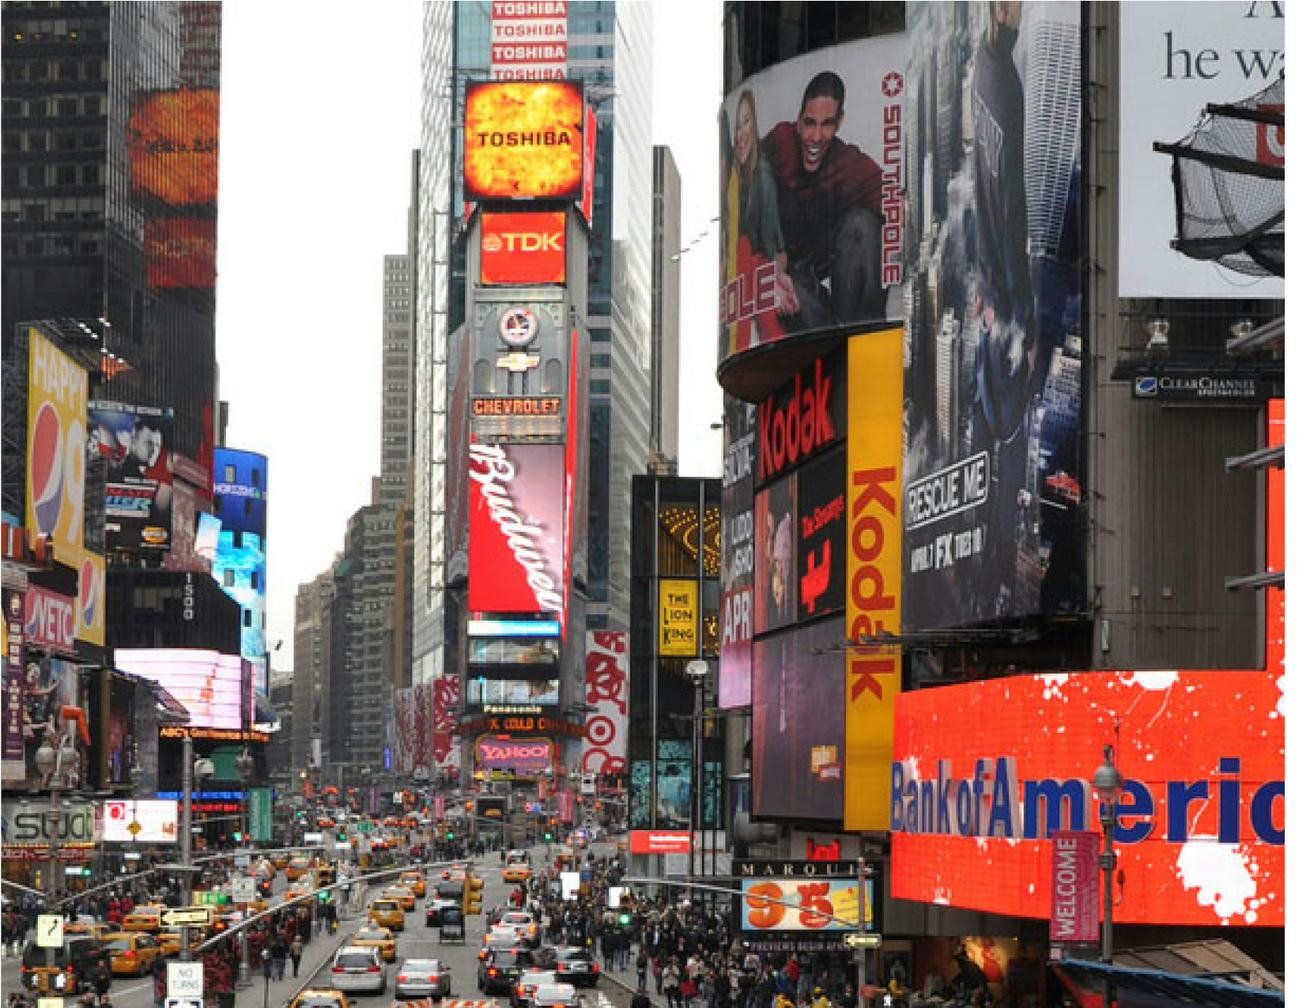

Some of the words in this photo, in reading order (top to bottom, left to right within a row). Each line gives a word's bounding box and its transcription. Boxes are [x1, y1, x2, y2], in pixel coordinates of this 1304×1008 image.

[494, 2, 566, 14] TOSHIBA
[494, 25, 566, 37] TOSHIBA
[494, 46, 567, 60] TOSHIBA
[1162, 31, 1221, 80] he
[494, 68, 566, 80] TOSHIBA
[477, 131, 571, 147] TOSHIBA
[882, 103, 904, 288] SOUTHPOLE
[500, 232, 563, 251] TDK
[474, 398, 560, 416] CHEVROLET
[758, 357, 836, 481] Kodak
[908, 469, 960, 523] RESCUE
[964, 459, 985, 502] ME
[851, 466, 897, 704] Kodak
[183, 572, 195, 621] 1500
[668, 592, 689, 605] THE
[663, 607, 693, 626] LION
[663, 626, 694, 645] KING
[480, 744, 550, 760] YAHOO!
[890, 759, 953, 835] Bank
[957, 758, 990, 836] of
[741, 863, 874, 877] MARQUIS
[1055, 837, 1078, 938] WELCOME
[797, 882, 834, 929] 5
